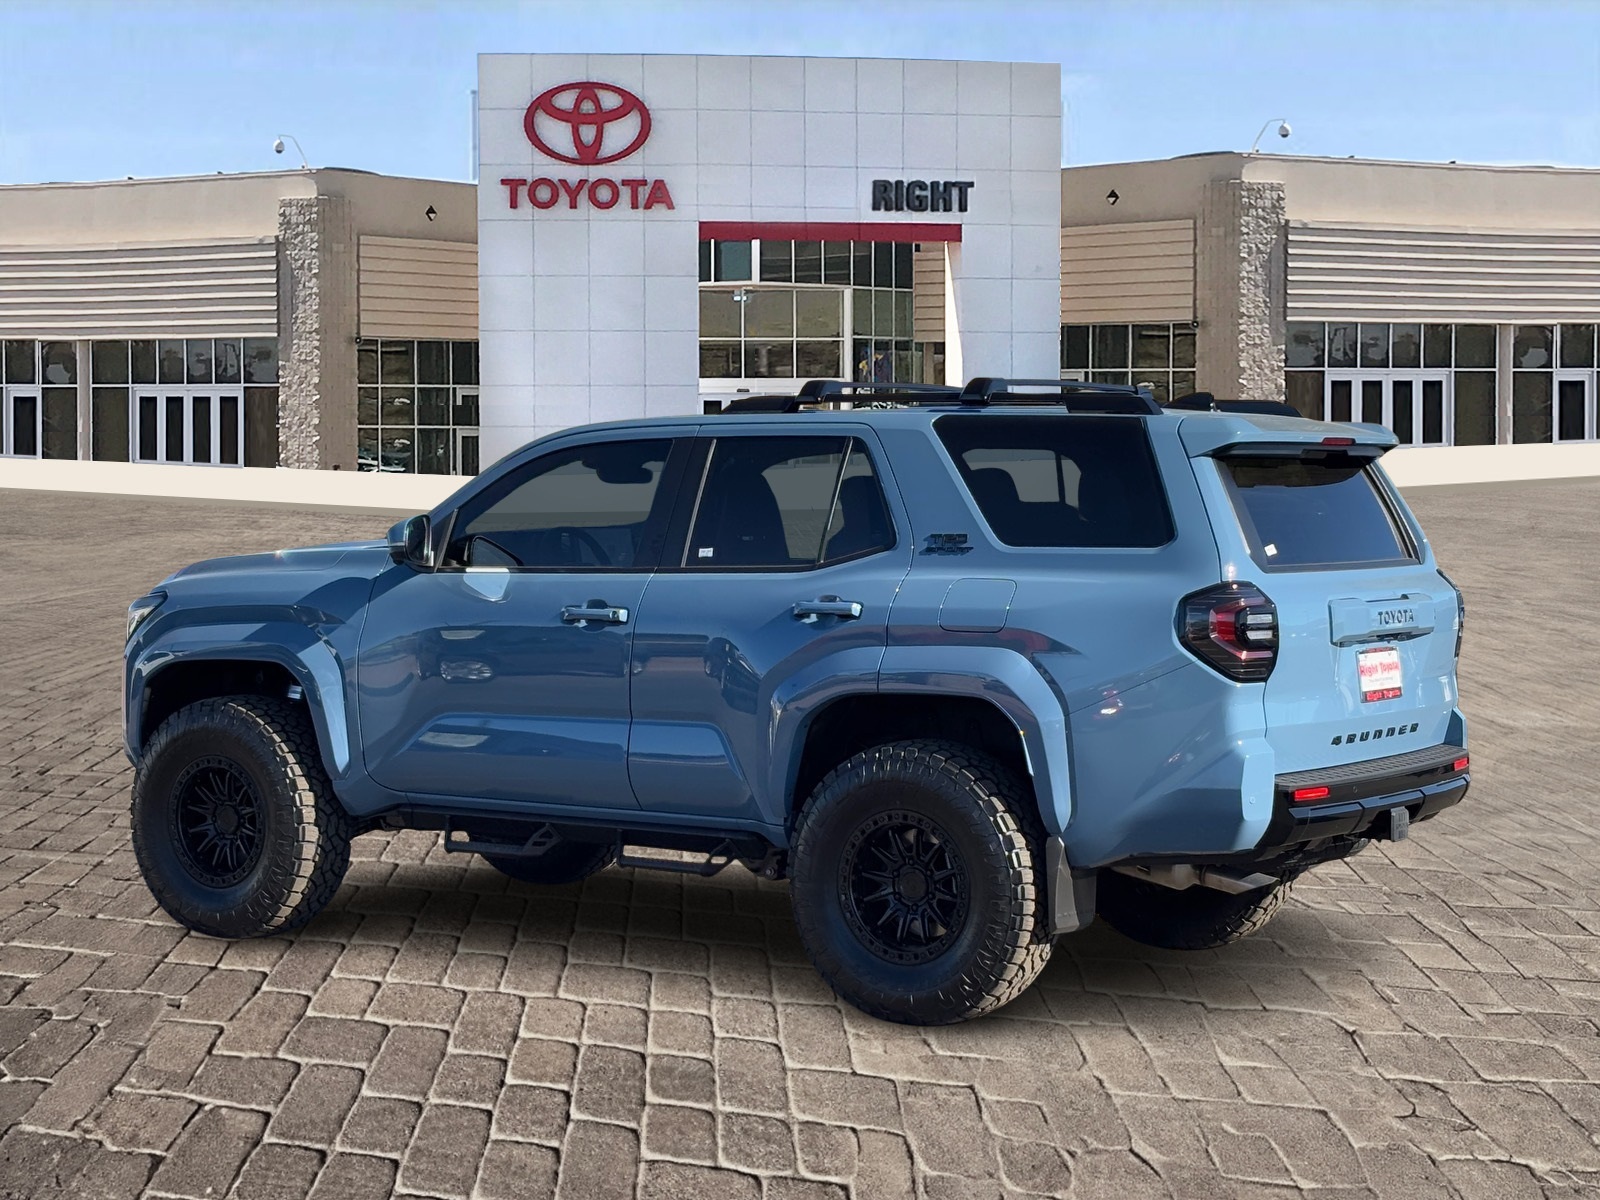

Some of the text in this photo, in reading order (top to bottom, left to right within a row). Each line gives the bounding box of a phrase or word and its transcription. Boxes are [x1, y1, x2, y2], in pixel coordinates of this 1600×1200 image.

[500, 178, 676, 210] TOYOTA
[872, 179, 975, 212] RIGHT
[1378, 609, 1414, 625] TOYOTA
[1359, 660, 1400, 677] Right Toyota
[1331, 723, 1419, 745] 4RUNNER
